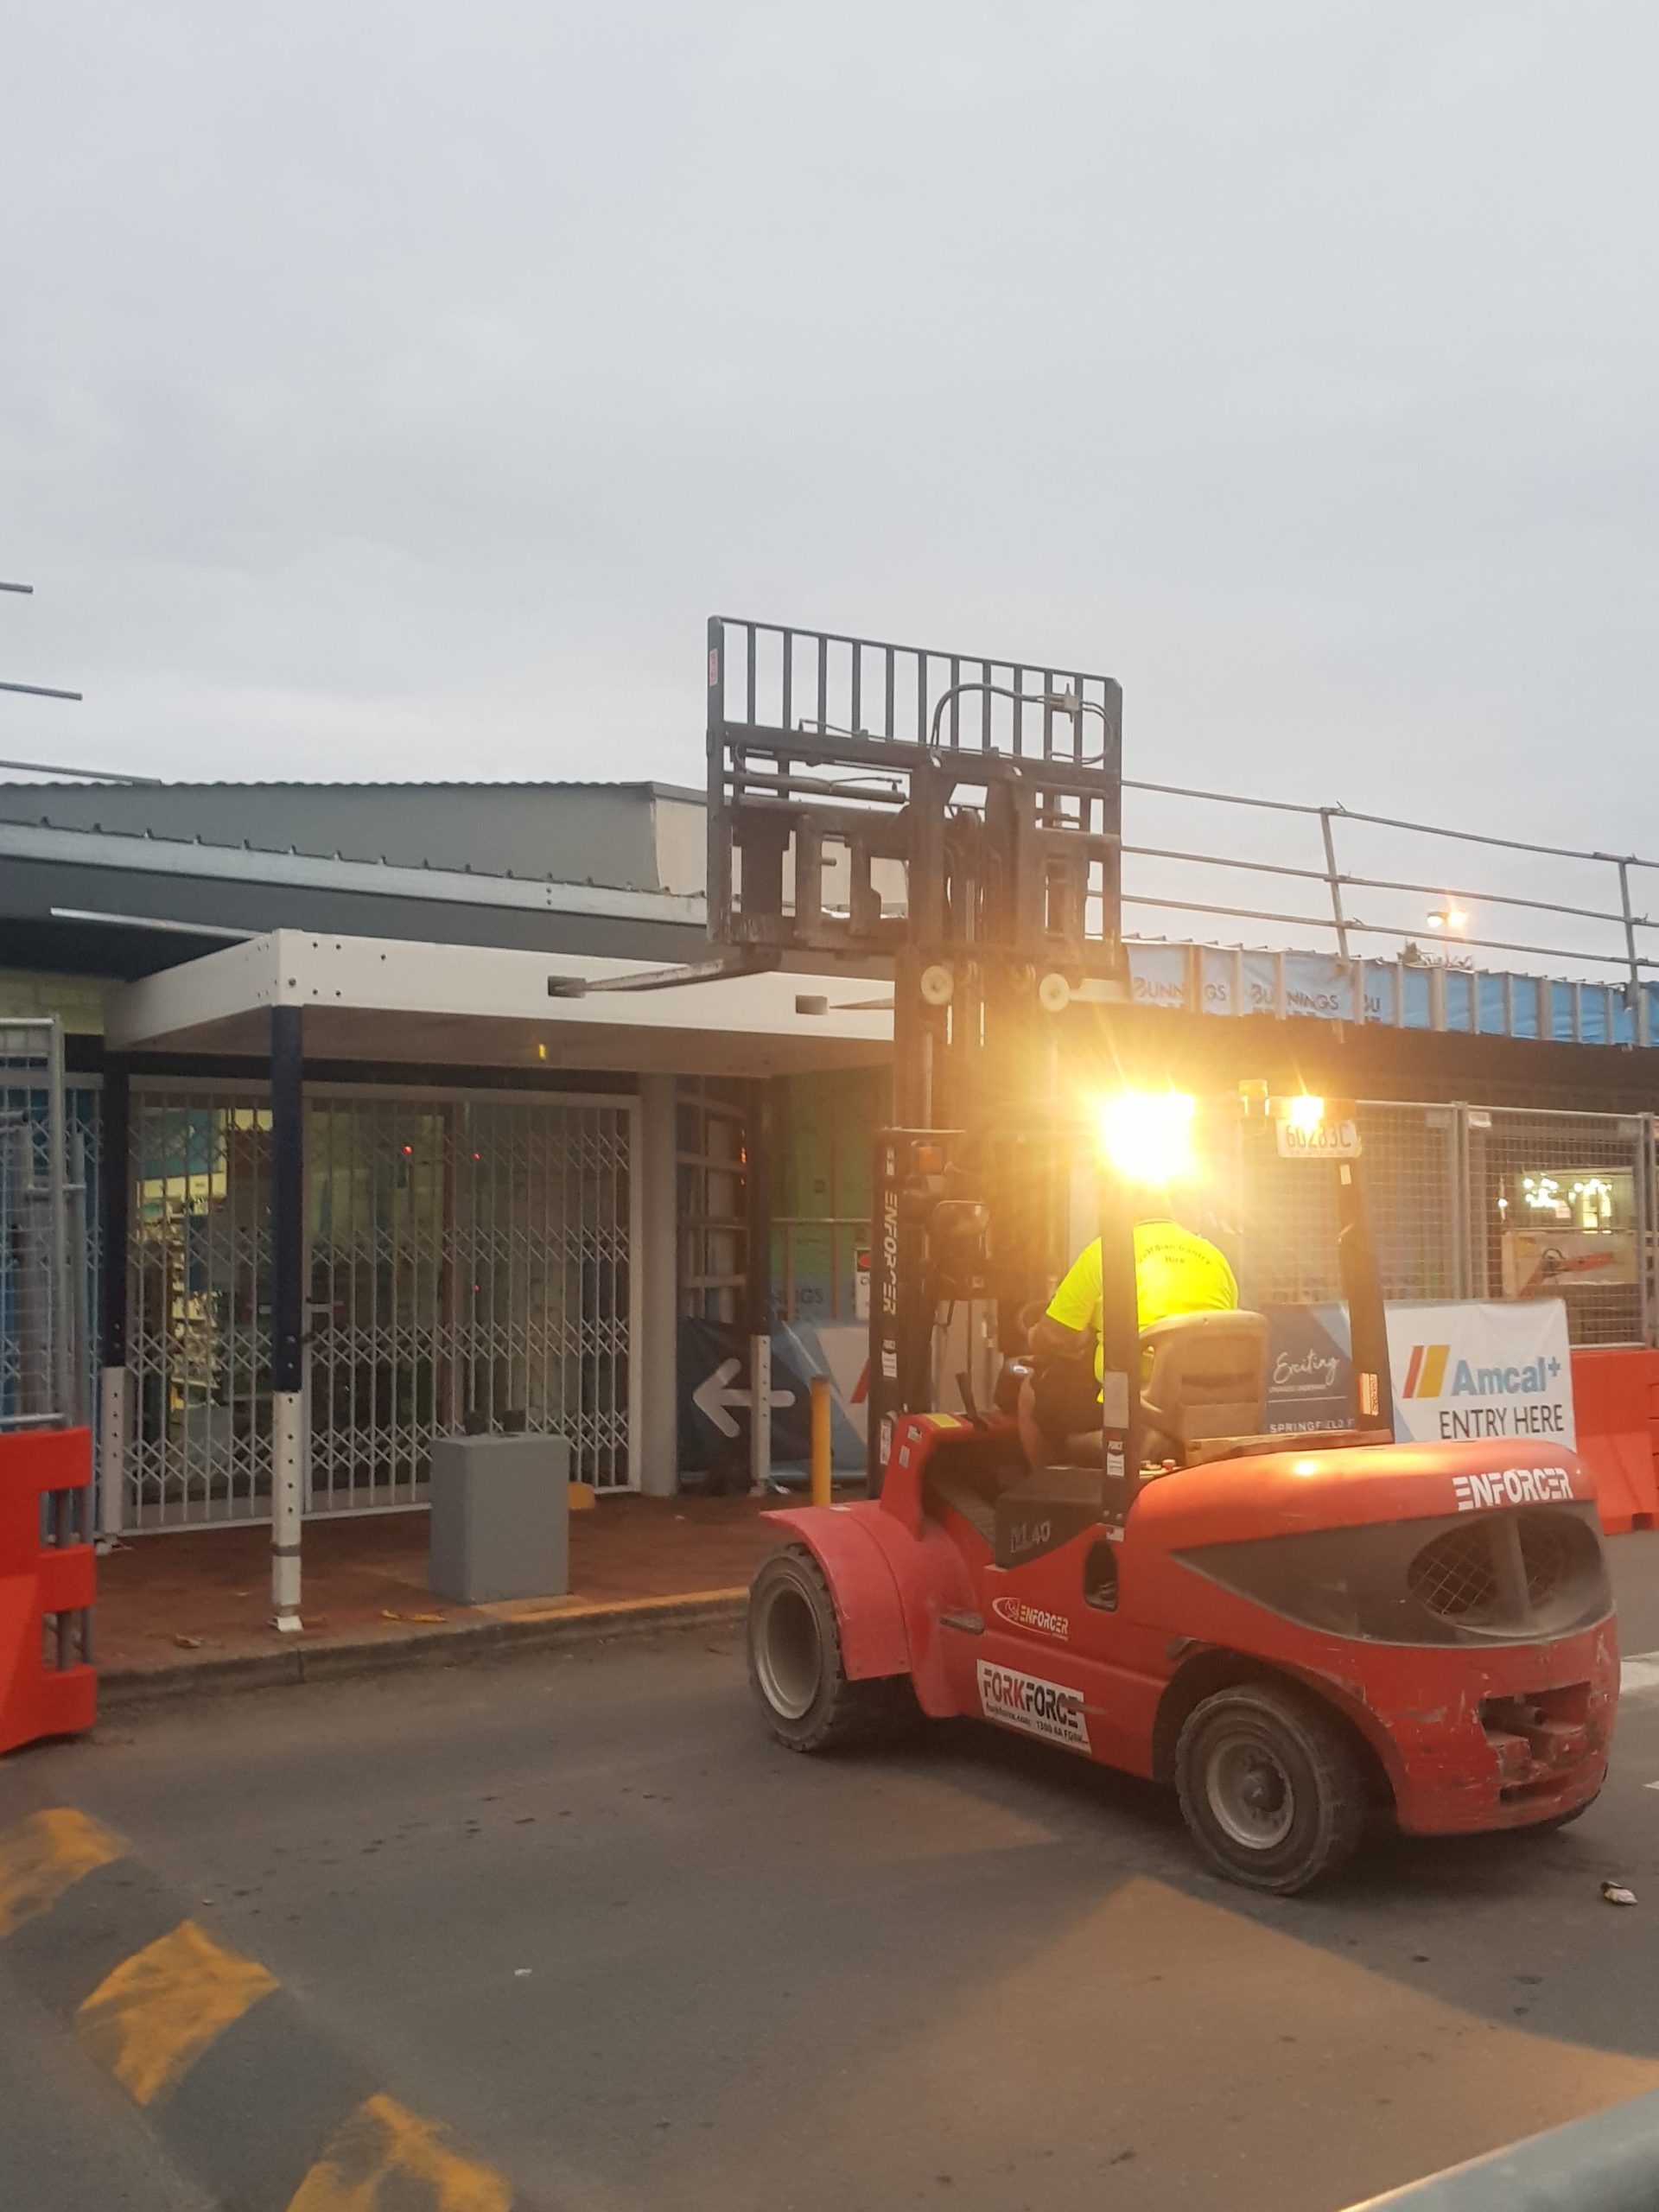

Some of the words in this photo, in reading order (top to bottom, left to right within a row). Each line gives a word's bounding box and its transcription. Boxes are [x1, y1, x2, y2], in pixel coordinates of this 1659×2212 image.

[1439, 1408, 1507, 1440] ENTRY
[1514, 1404, 1565, 1434] HERE
[1452, 1467, 1573, 1511] ENFORCER
[1020, 1605, 1069, 1635] ENFORCER
